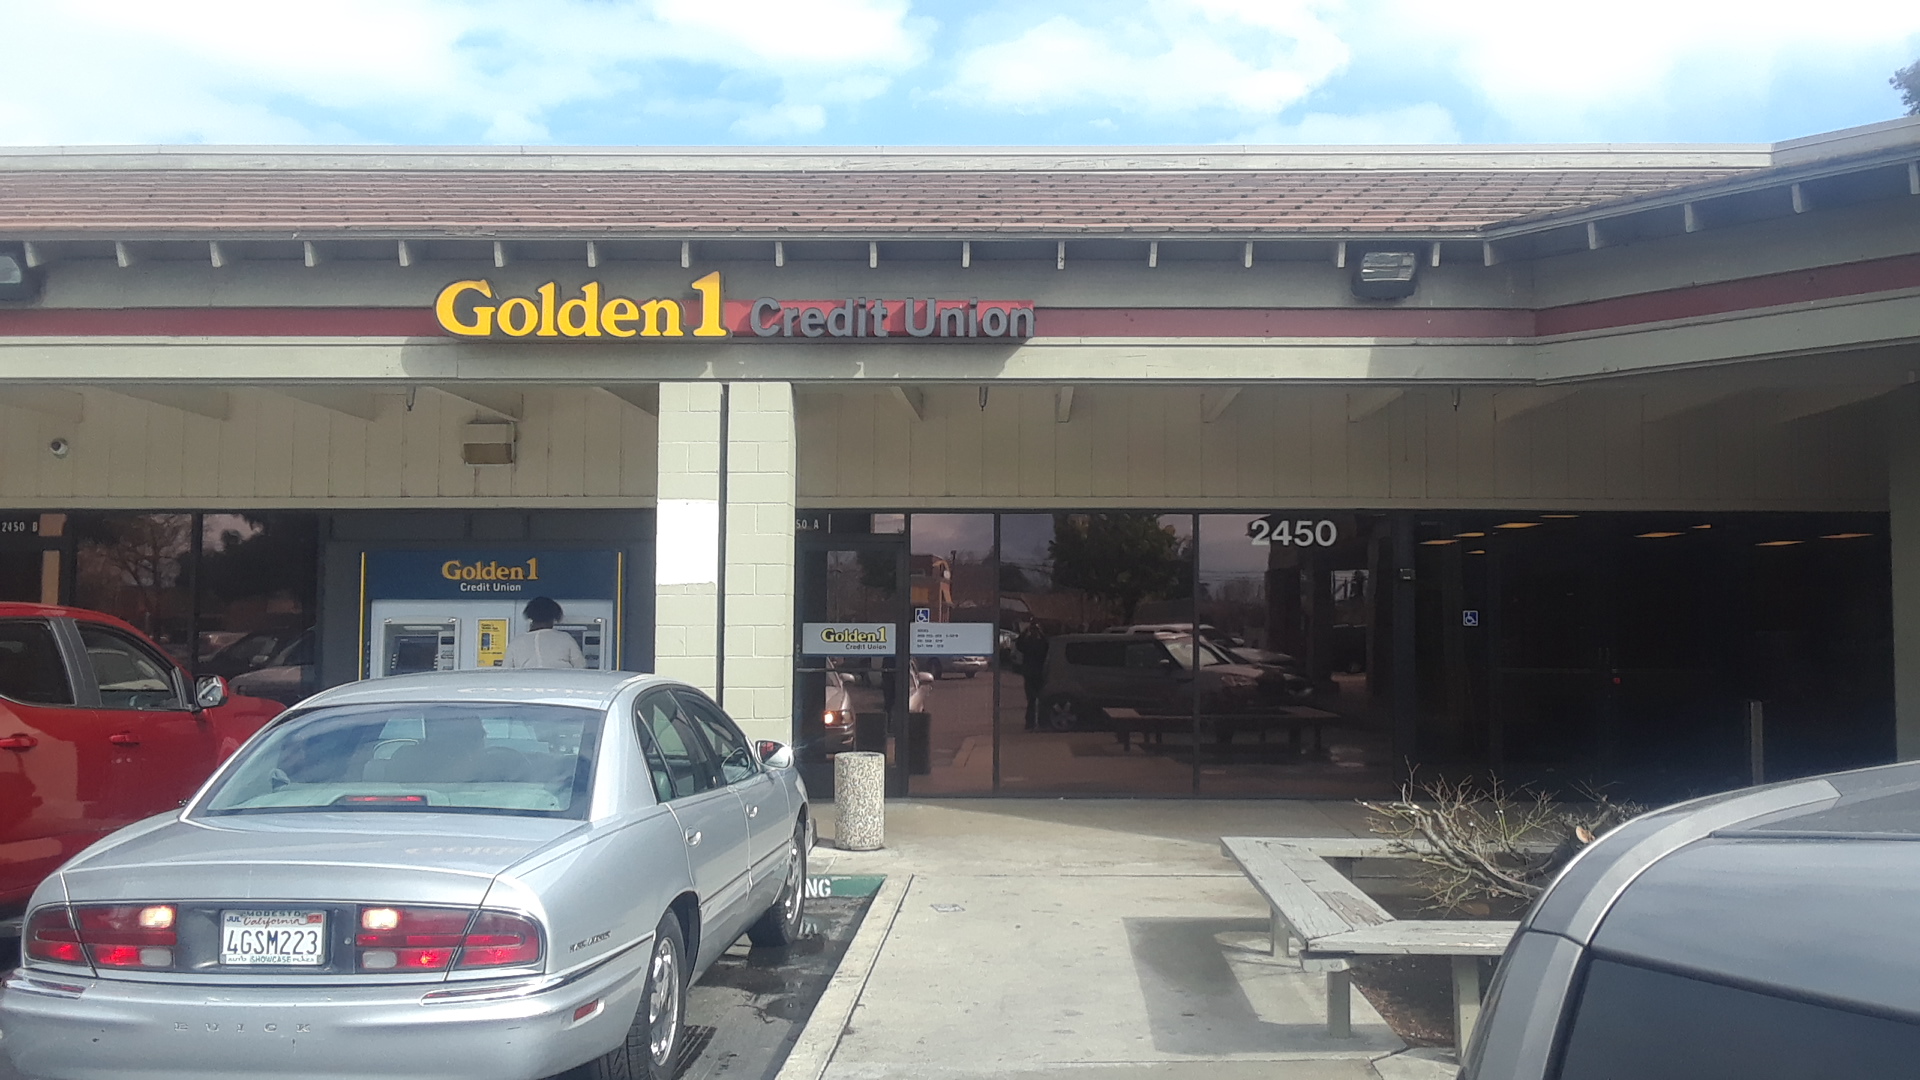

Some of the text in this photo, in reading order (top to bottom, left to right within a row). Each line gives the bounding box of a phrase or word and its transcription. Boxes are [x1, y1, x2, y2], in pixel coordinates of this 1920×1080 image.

[749, 297, 889, 338] Credit
[903, 297, 1036, 338] Union
[1, 521, 25, 532] 2450
[796, 519, 819, 529] 50 A
[1250, 519, 1337, 547] 2450
[460, 583, 521, 592] Credit Union
[805, 878, 831, 898] NG
[243, 917, 308, 929] California
[226, 930, 318, 955] 4GSM223
